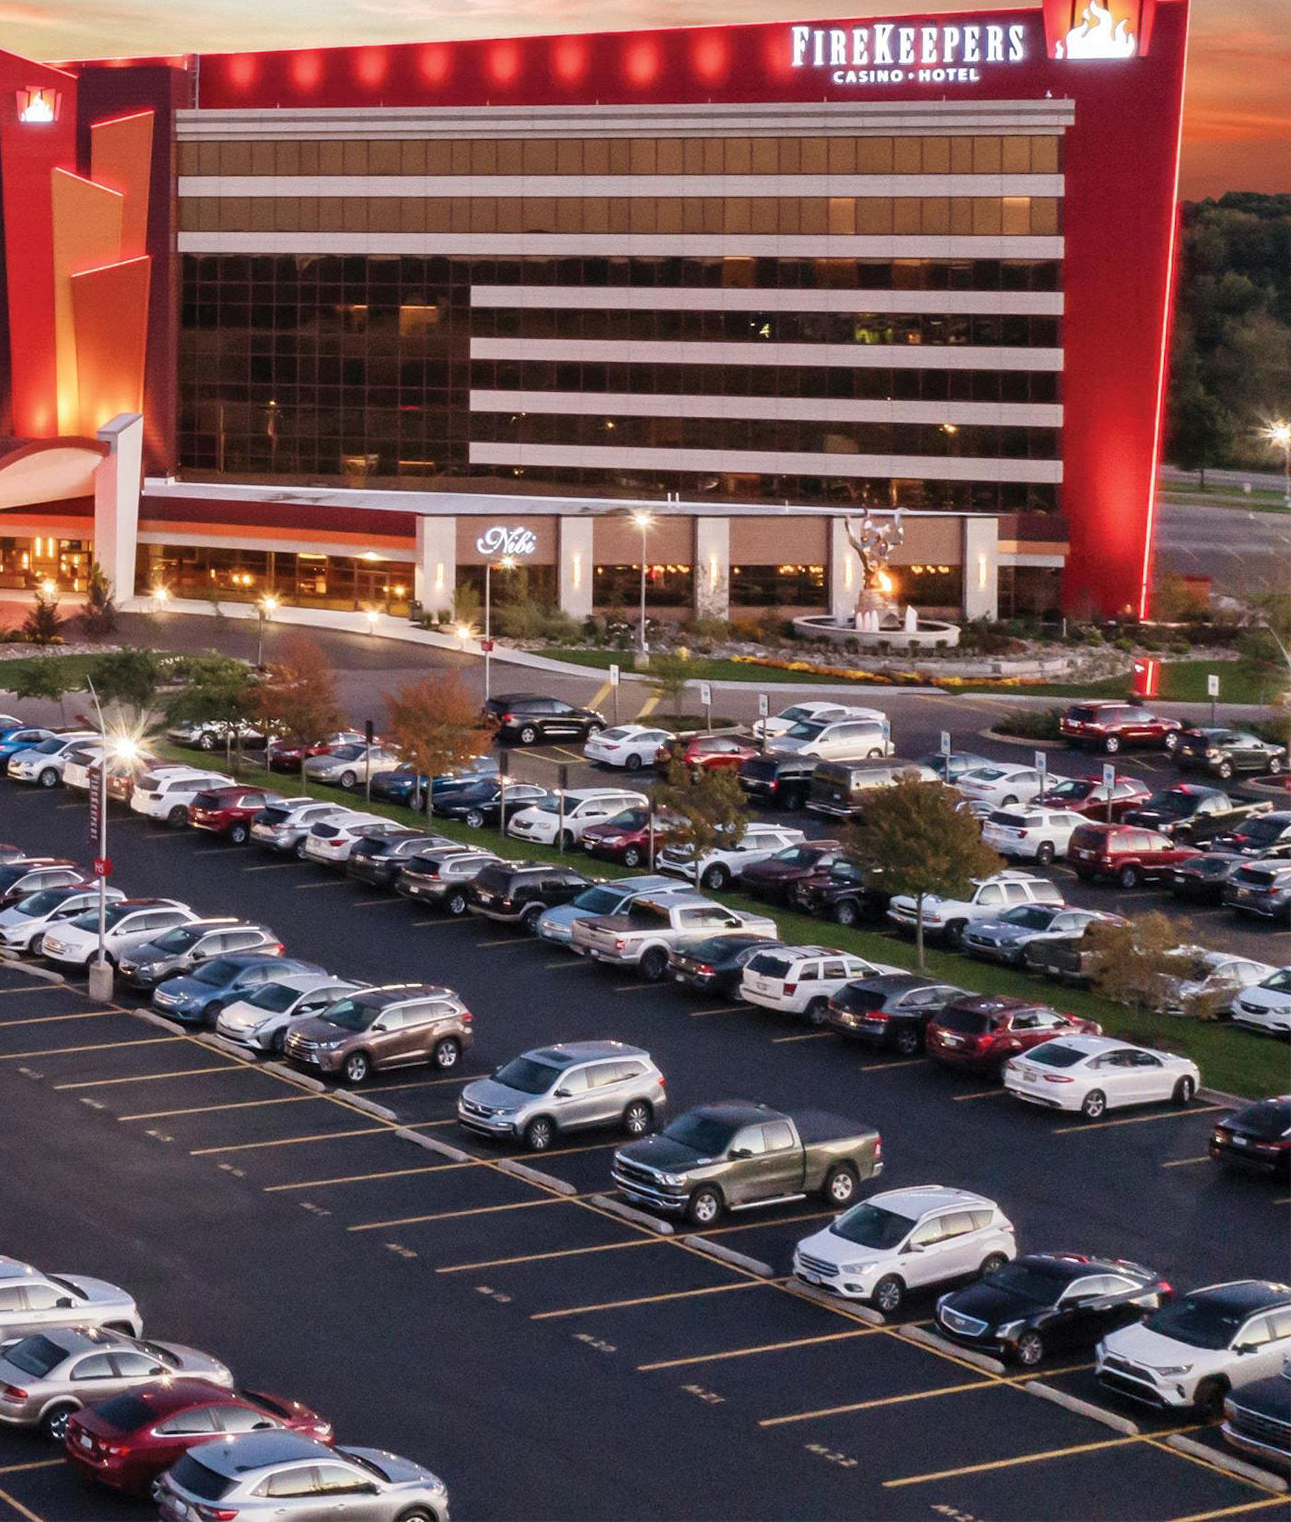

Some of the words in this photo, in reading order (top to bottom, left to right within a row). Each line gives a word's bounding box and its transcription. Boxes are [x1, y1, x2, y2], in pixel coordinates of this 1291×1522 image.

[832, 69, 904, 84] CASINO
[918, 67, 980, 82] HOTEL
[476, 526, 537, 554] Nibi
